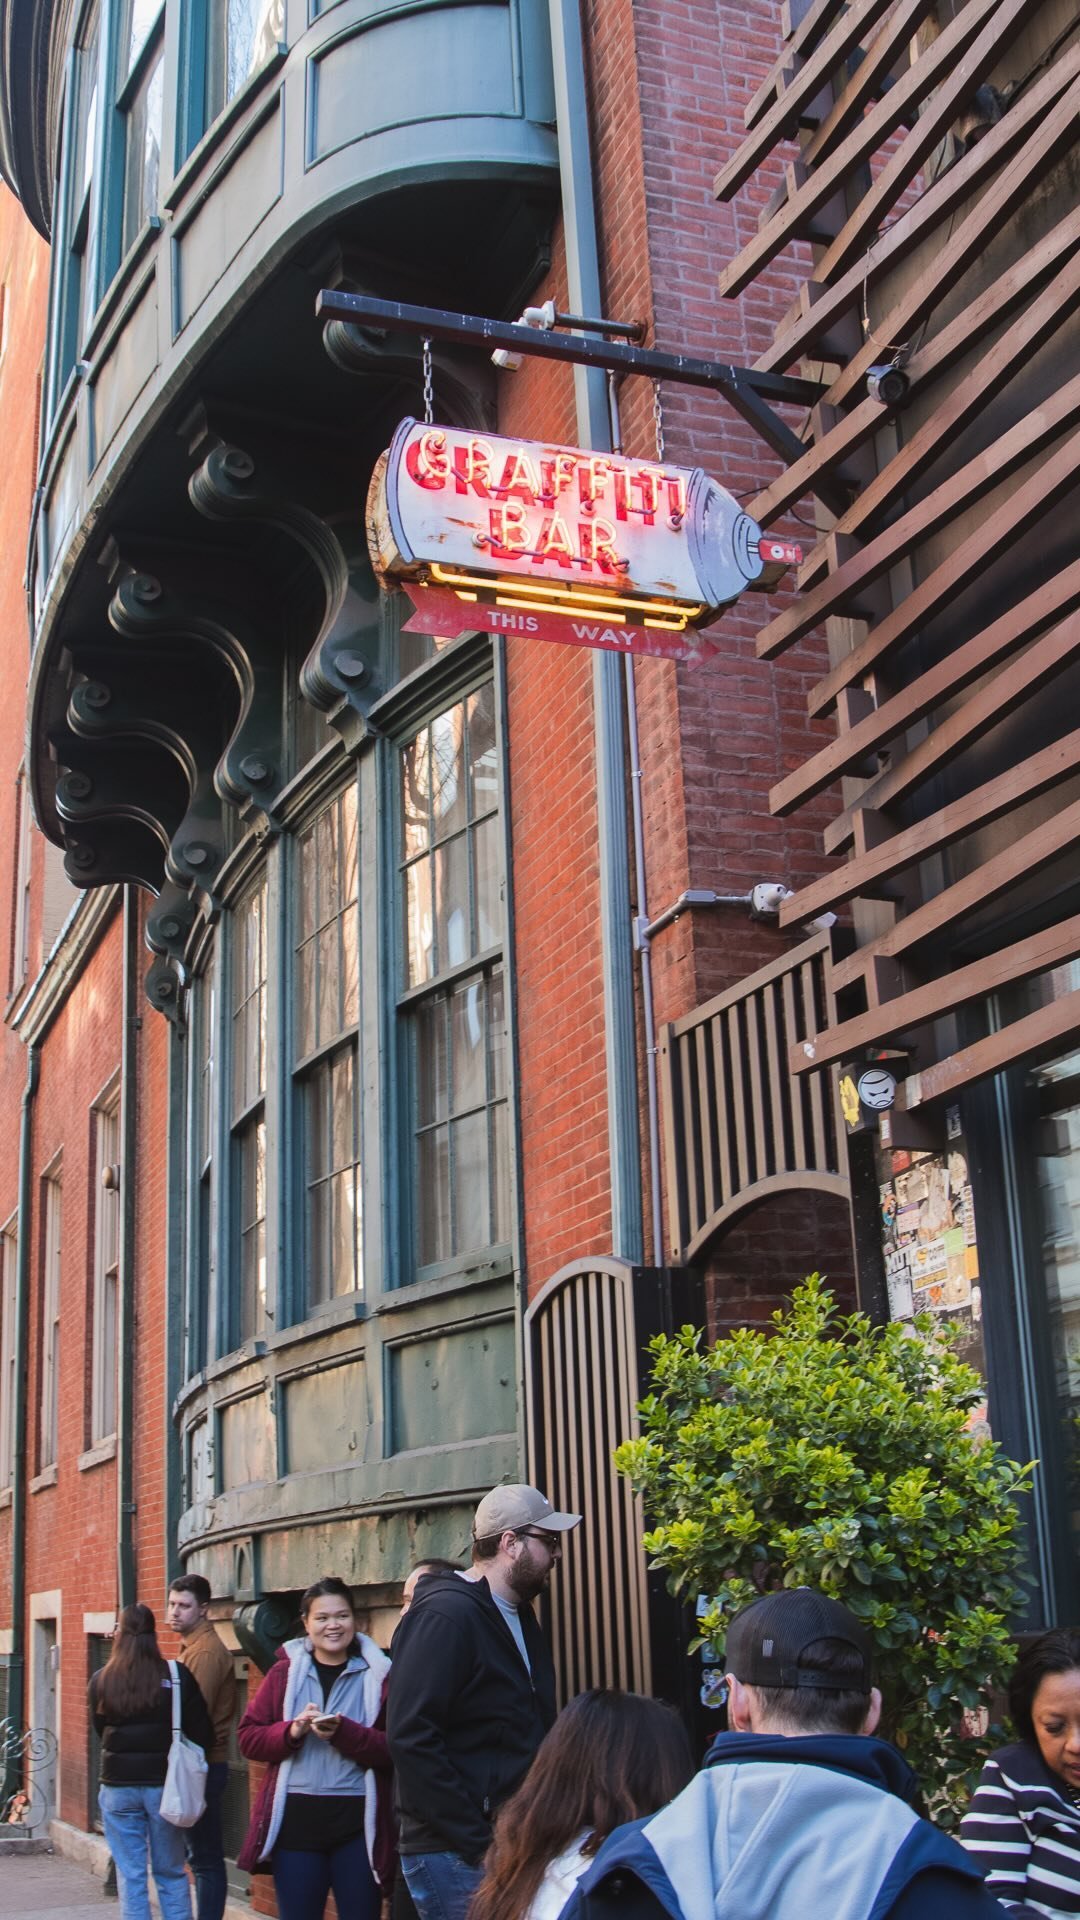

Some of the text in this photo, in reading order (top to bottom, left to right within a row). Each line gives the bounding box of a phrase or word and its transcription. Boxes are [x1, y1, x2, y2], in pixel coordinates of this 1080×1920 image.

[406, 430, 687, 527] GRAFFITI
[489, 501, 620, 575] BAR
[487, 611, 637, 646] THIS WAY
